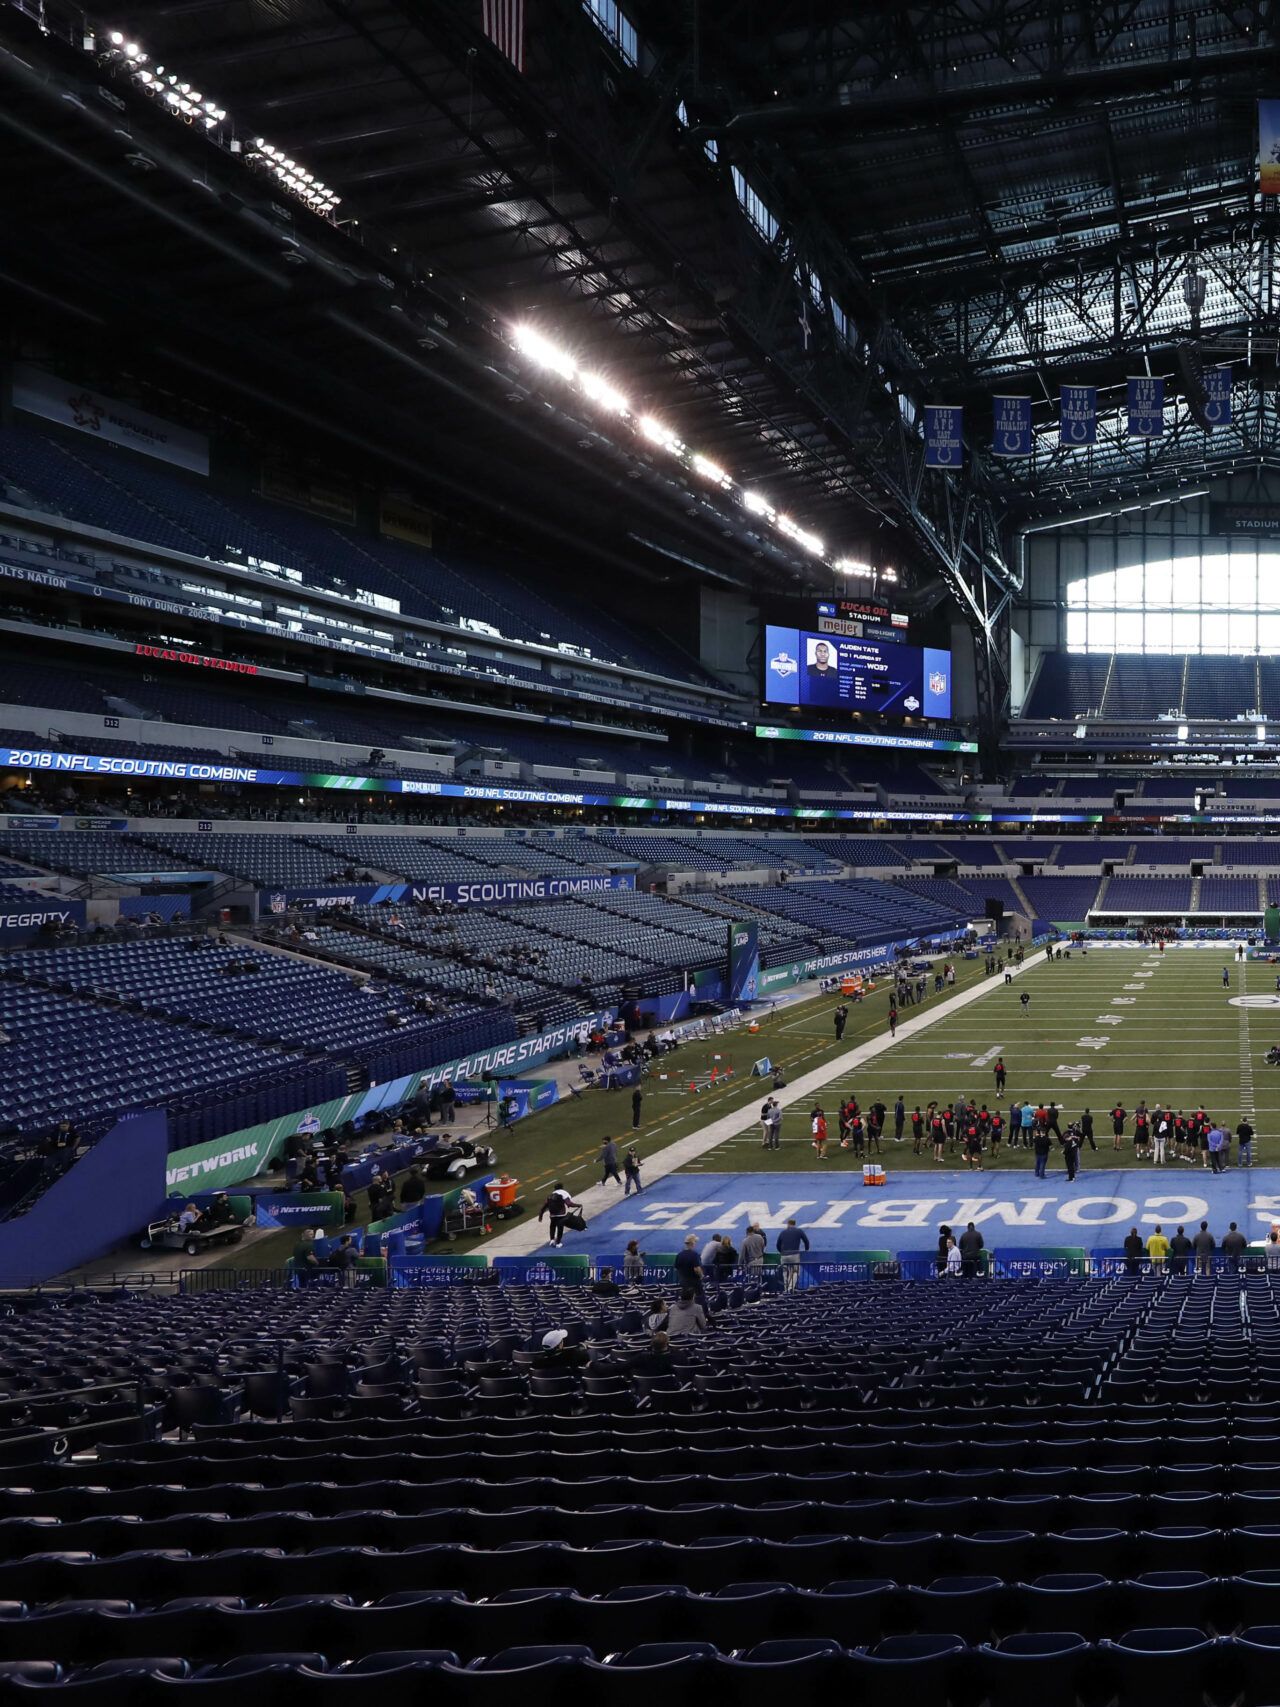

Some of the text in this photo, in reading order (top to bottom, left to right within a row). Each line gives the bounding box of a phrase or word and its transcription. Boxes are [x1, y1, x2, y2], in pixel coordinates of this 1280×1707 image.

[1135, 389, 1155, 400] AFC
[1066, 400, 1089, 410] AFC
[1001, 411, 1022, 421] AFC
[1062, 408, 1094, 419] WILDCARD
[933, 418, 954, 431] AFC
[996, 420, 1028, 431] FINALIST
[1235, 520, 1279, 528] STADIUM
[27, 571, 67, 588] NATION
[128, 594, 220, 623] TONY DUNGY 2002-08
[840, 601, 889, 617] LUCAS OIL
[849, 612, 881, 623] STADIUM
[824, 618, 858, 634] meijer
[265, 626, 330, 648] MARVIN HARRISON
[135, 644, 258, 676] LUCAS OIL STADIUM
[813, 732, 934, 748] 2018 NFL SCOUTING COMBINE
[8, 750, 258, 782] 2018 NFL SCOUTING COMBINE
[464, 786, 584, 803] 2018 NFL SCOUTING COMBINE
[704, 803, 776, 815] 2018 NFL SCOUTING COMBINE
[456, 881, 545, 903] SCOUTING
[549, 878, 612, 896] COMBINE
[804, 946, 887, 973] THE FUTURE STARTS HERE
[456, 1046, 517, 1083] FUTURE
[518, 1032, 564, 1061] STARTS
[566, 1018, 598, 1043] HERE
[165, 1142, 258, 1186] NETWORK
[490, 1191, 500, 1202] G
[280, 1204, 332, 1214] NETWORK
[613, 1194, 1209, 1231] COMBINE
